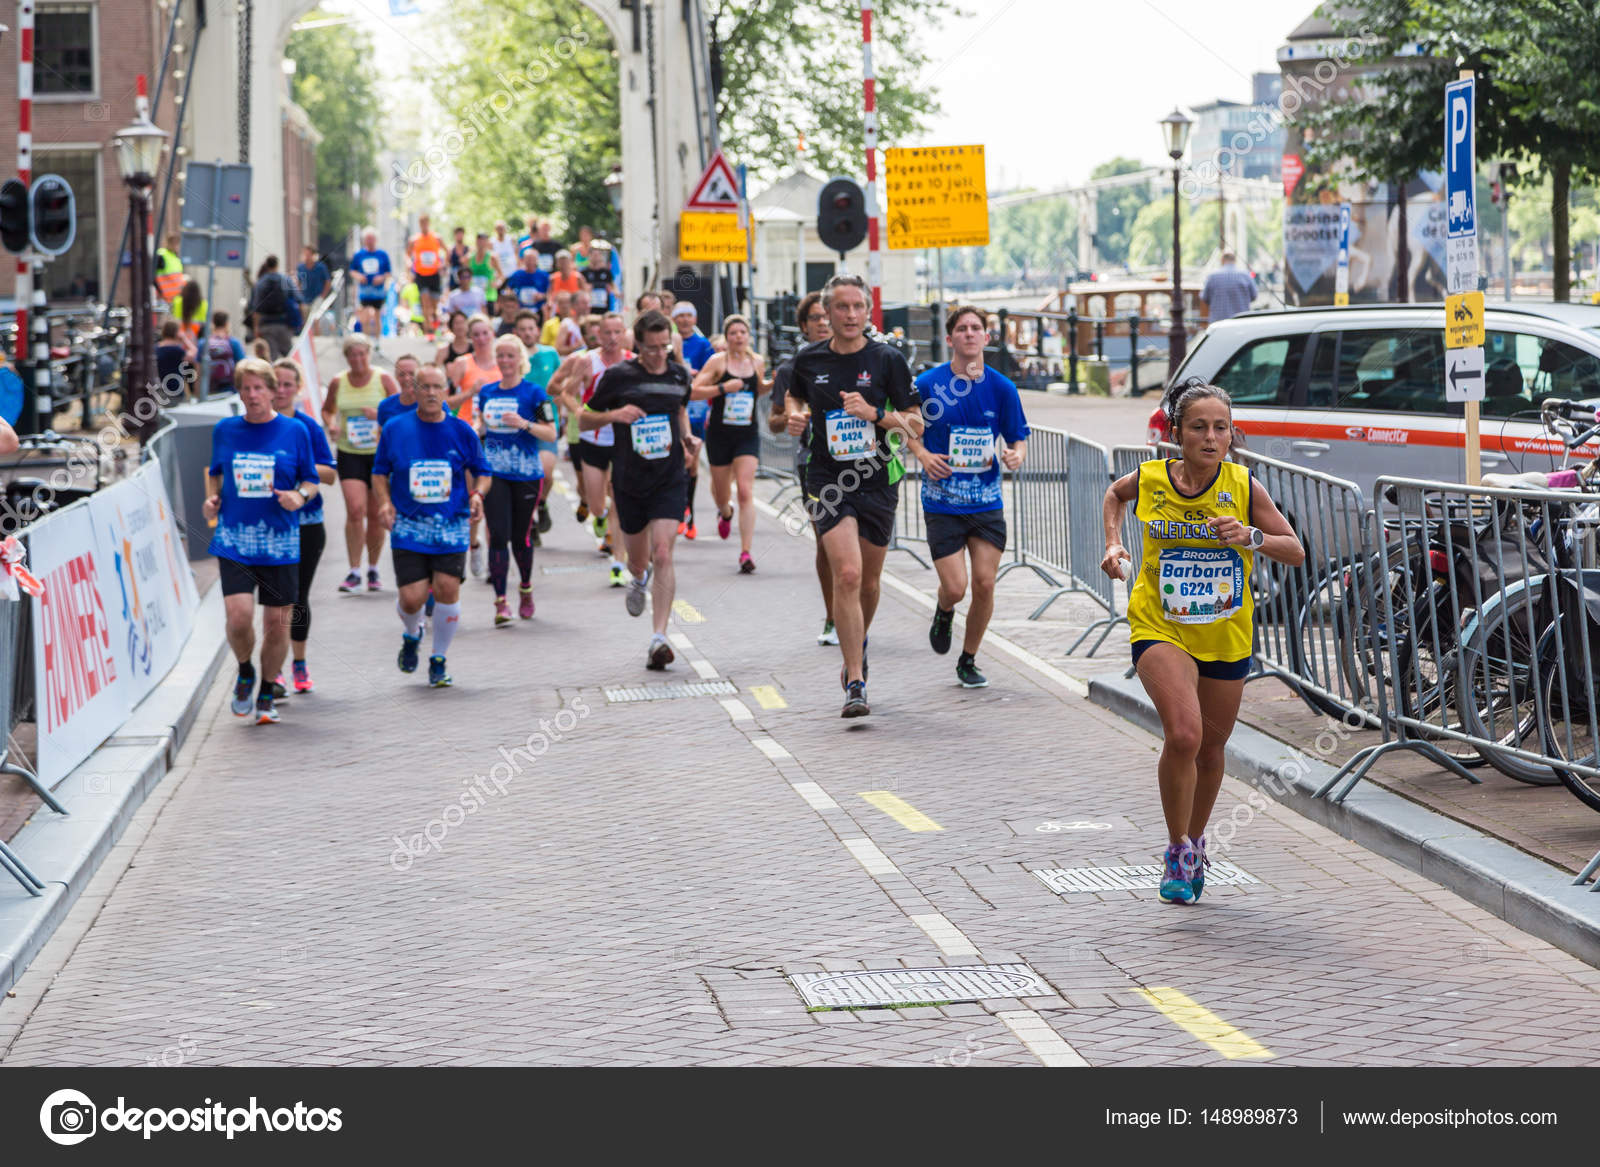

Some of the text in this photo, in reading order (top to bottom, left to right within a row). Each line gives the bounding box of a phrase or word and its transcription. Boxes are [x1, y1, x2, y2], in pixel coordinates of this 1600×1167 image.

[1452, 96, 1468, 173] P
[836, 419, 868, 431] Anita
[841, 431, 863, 442] 8424
[1184, 510, 1208, 521] G.S.
[1182, 550, 1230, 561] BROOKS
[1162, 563, 1233, 578] Barbara
[1180, 582, 1214, 597] 6224
